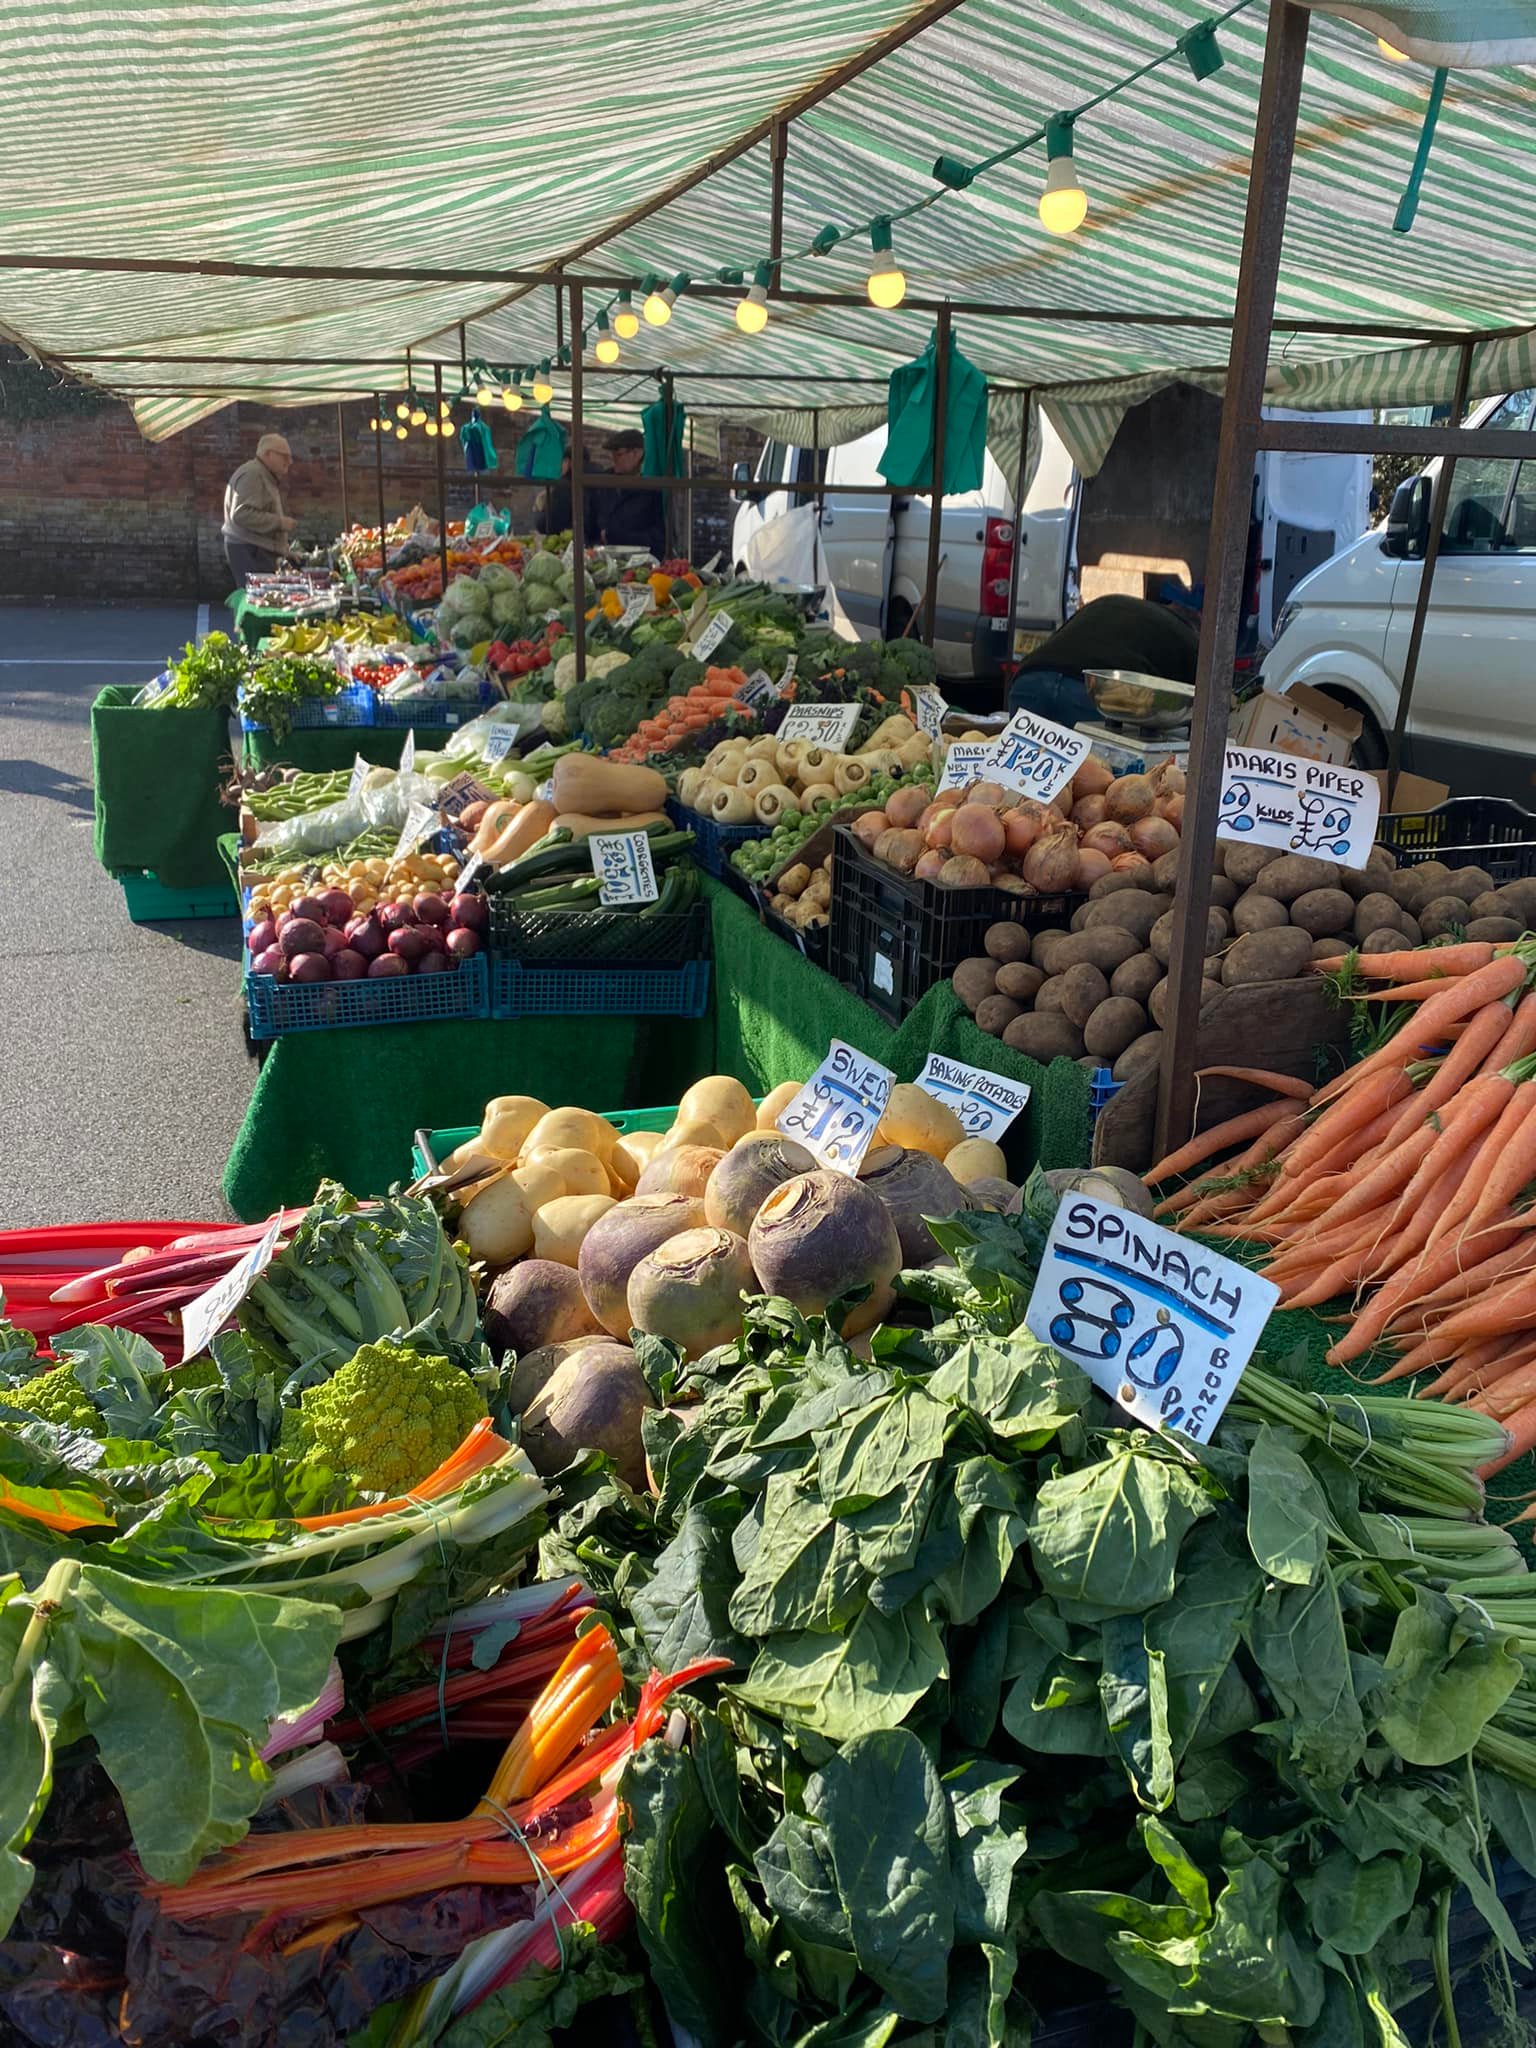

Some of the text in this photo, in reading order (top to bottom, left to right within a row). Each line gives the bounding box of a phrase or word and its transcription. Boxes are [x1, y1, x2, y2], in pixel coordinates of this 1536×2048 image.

[789, 705, 845, 717] PARSNIPS
[1014, 715, 1083, 757] ONIONS
[1226, 750, 1364, 798] MARIS PIPER
[1256, 803, 1295, 822] KILOS
[1289, 796, 1351, 857] £2
[928, 1057, 976, 1088] BAKING
[973, 1075, 1026, 1110] POTATOES
[1065, 1203, 1242, 1319] SPINACH
[1184, 1347, 1230, 1438] BUNCH
